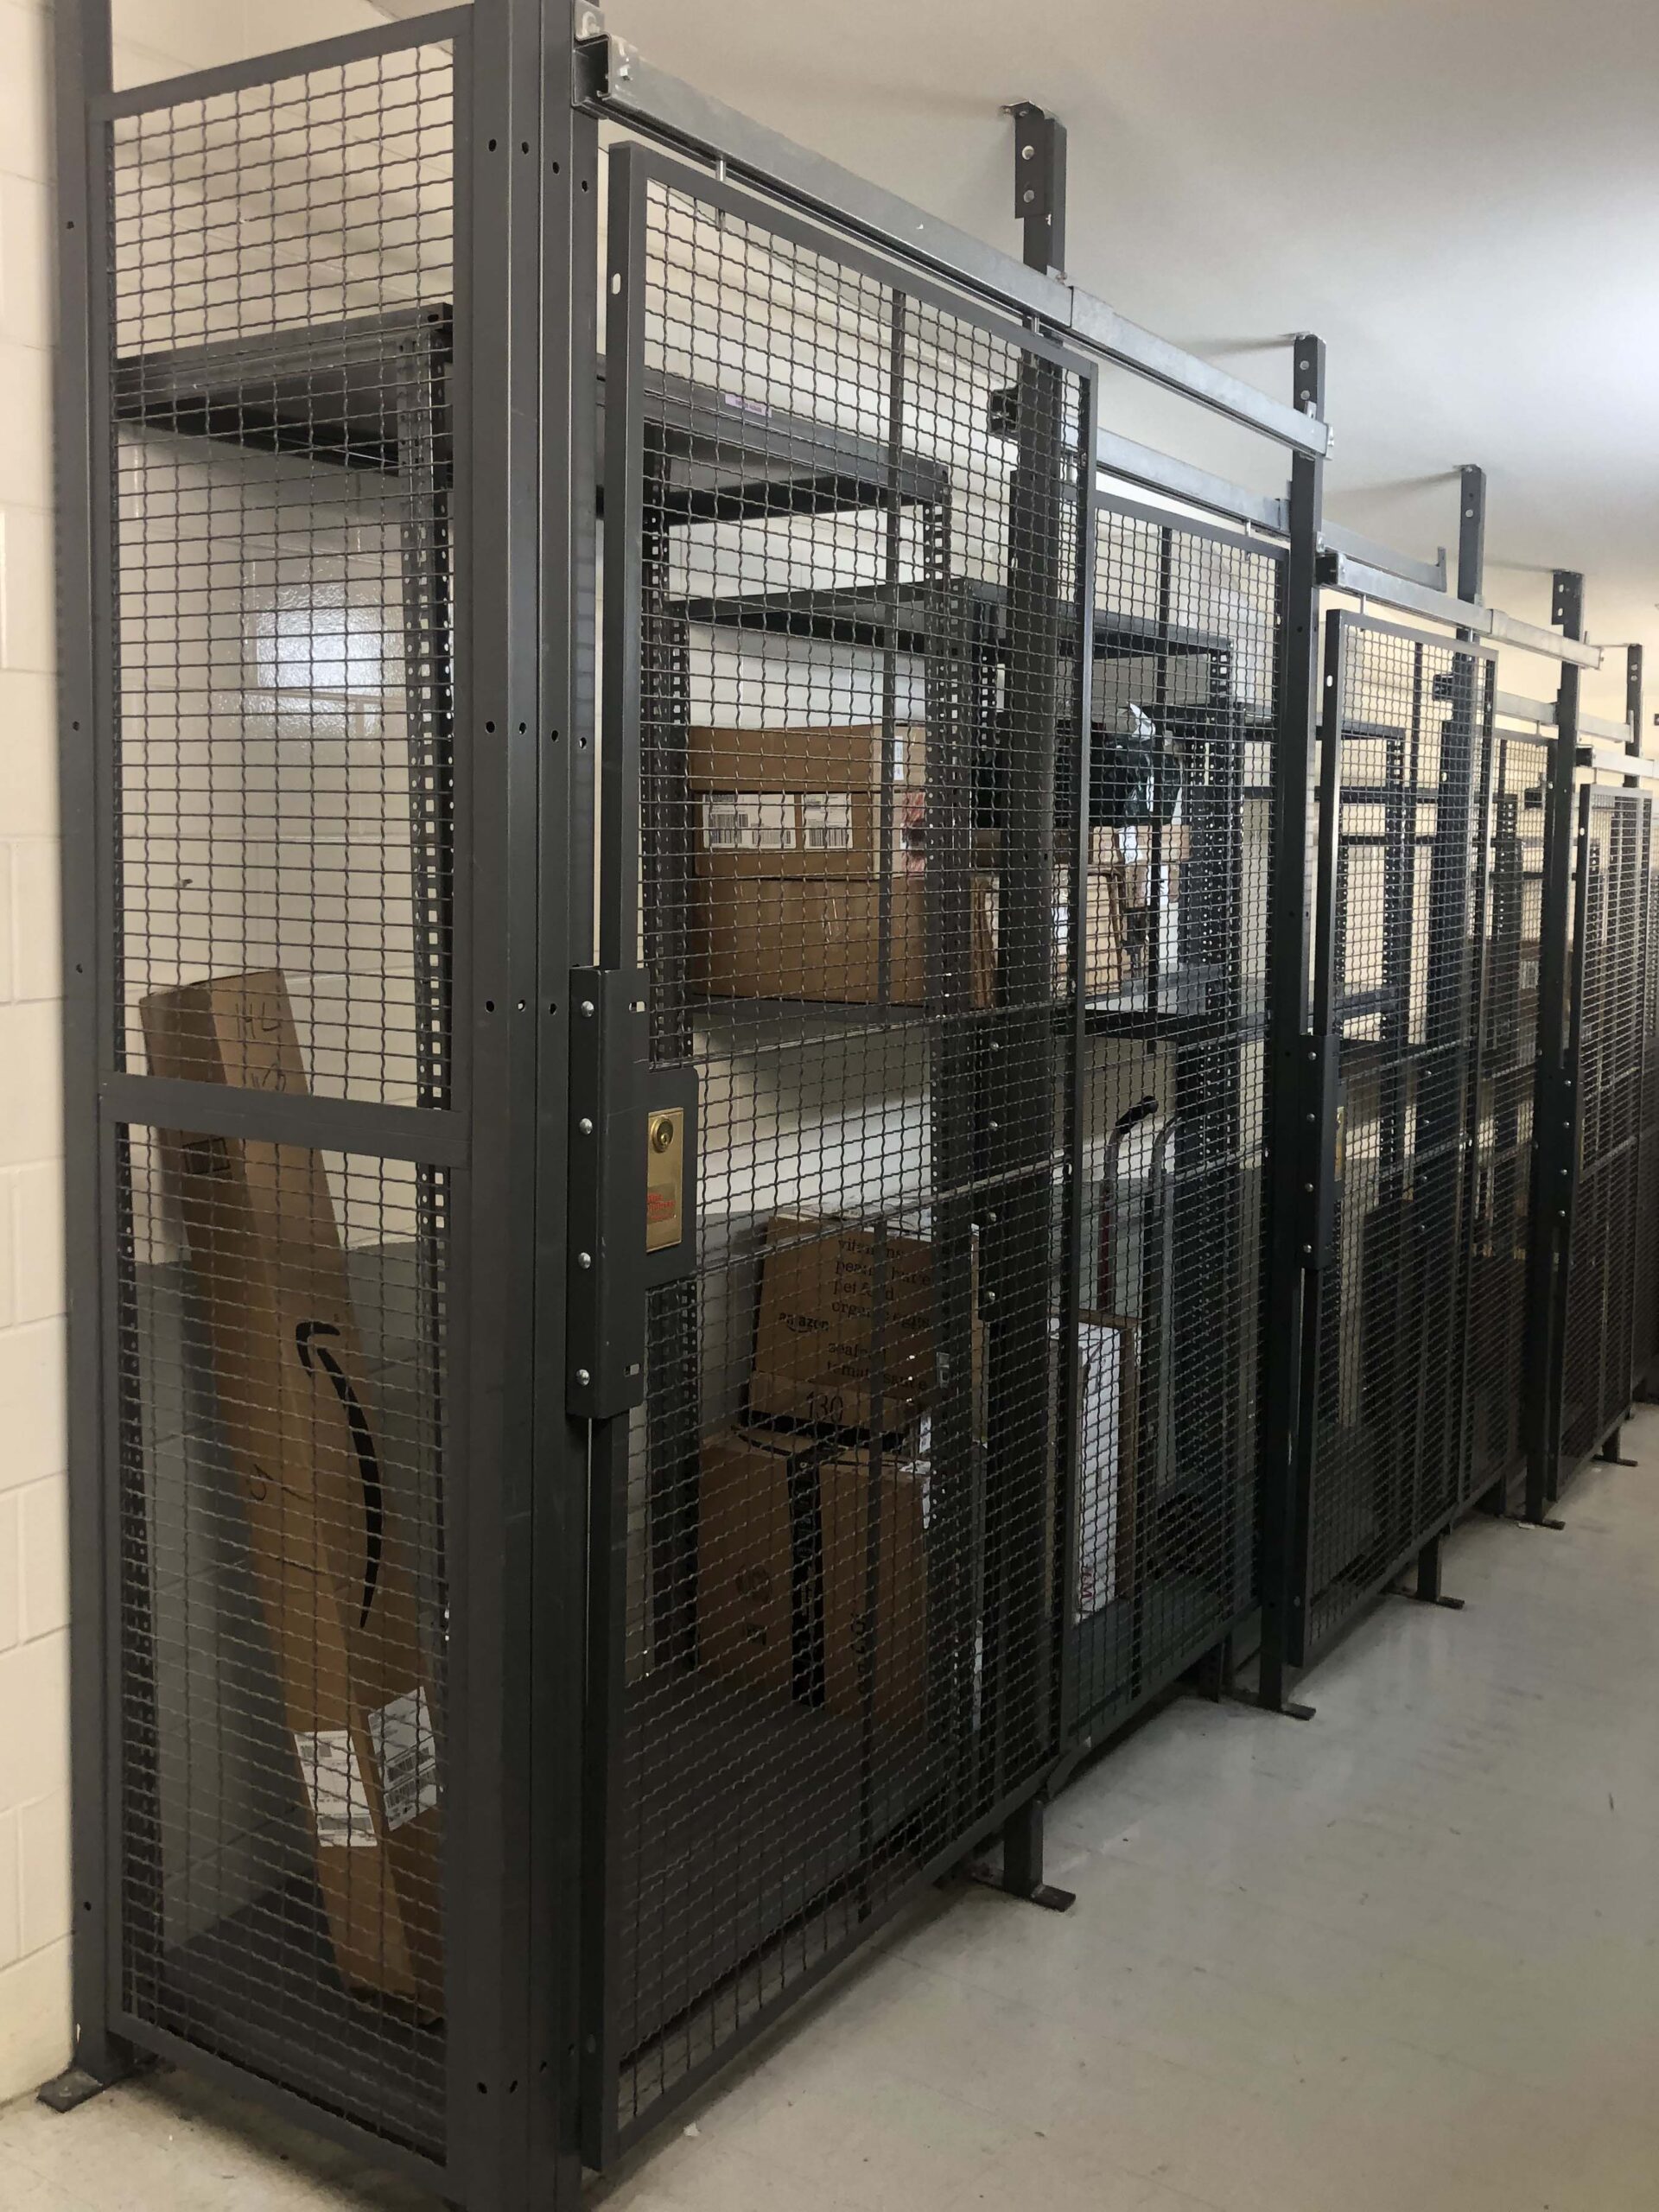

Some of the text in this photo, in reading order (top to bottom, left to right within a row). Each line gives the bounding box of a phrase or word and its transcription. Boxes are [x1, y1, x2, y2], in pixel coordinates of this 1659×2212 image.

[838, 1238, 905, 1259] vitamns
[831, 1301, 887, 1320] organ
[827, 1361, 873, 1379] tomat
